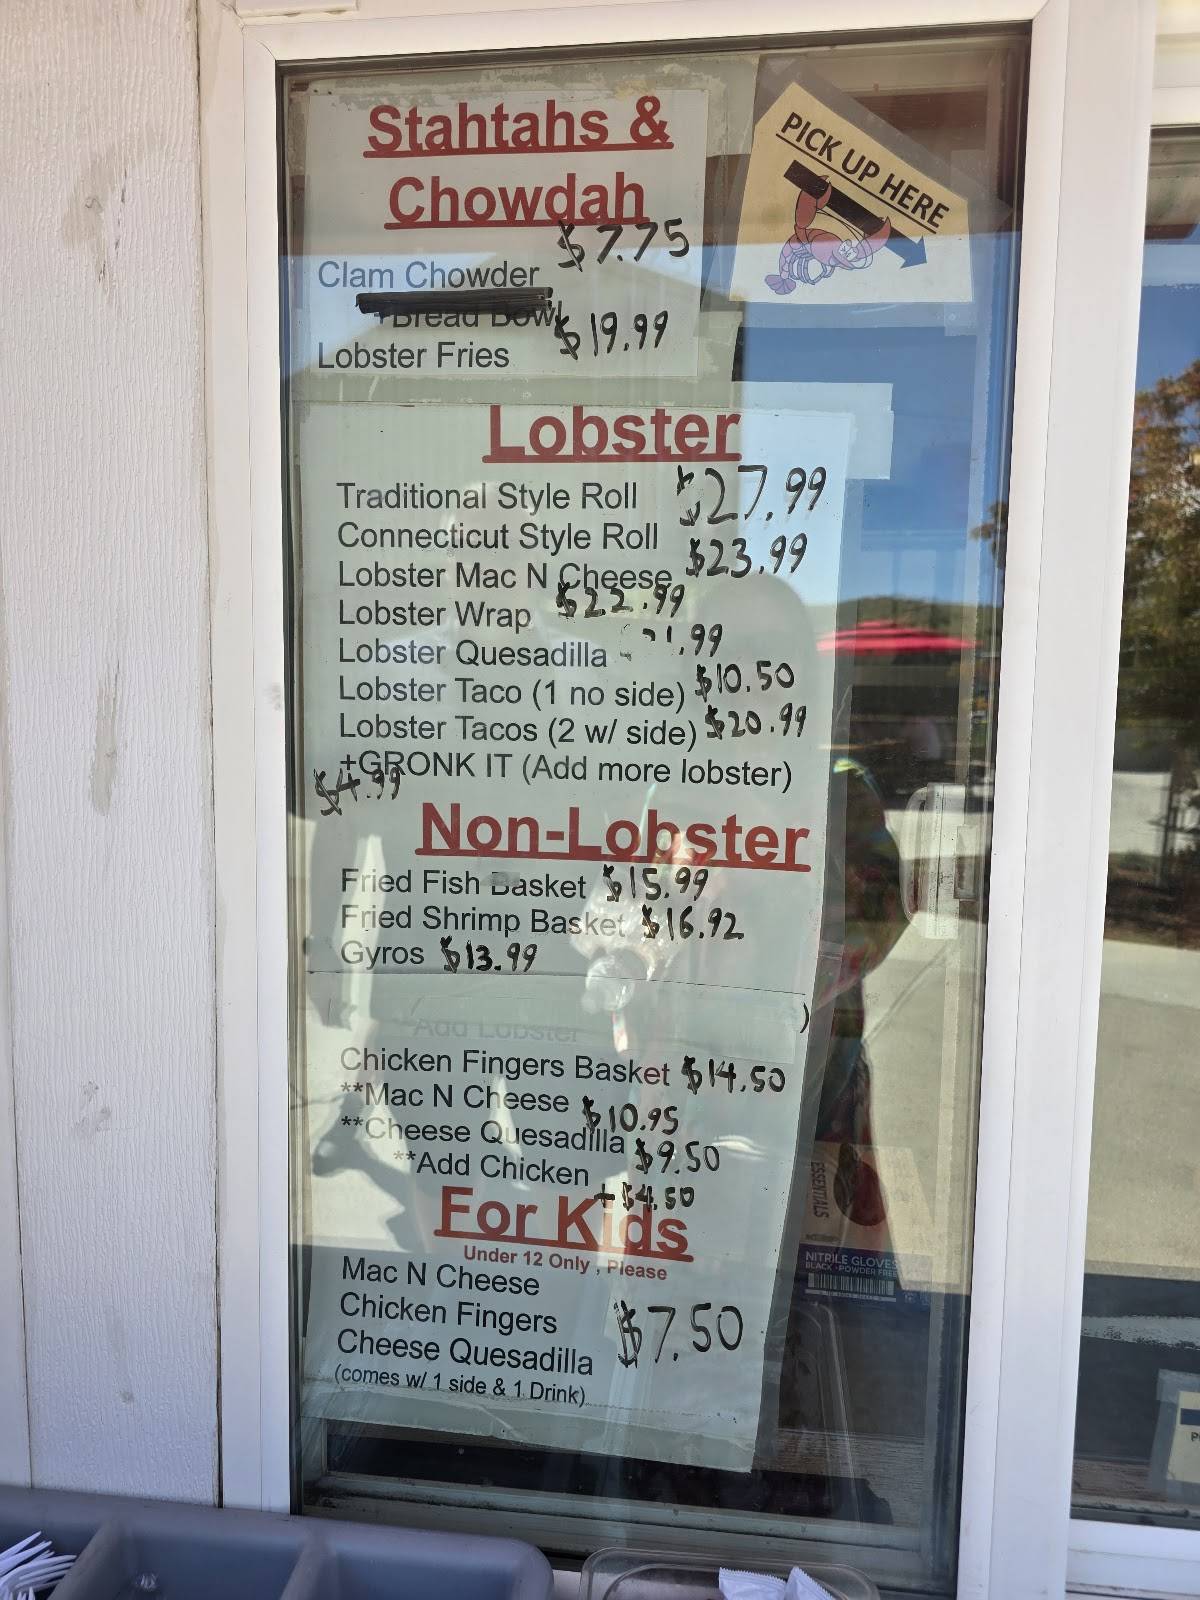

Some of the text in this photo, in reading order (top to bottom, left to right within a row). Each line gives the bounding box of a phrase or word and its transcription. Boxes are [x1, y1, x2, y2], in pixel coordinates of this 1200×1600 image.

[368, 95, 670, 152] Stahtahs &
[780, 111, 949, 229] PICK UP HERE
[389, 172, 646, 223] Chowdah
[557, 218, 690, 272] $7.75
[318, 261, 540, 289] Clam Chowder
[553, 310, 669, 361] $19.99
[318, 341, 510, 370] Lobster Fries
[489, 404, 741, 456] Lobster
[336, 482, 638, 516] Traditional Style Roll
[336, 521, 659, 556] Connecticut Style Roll
[686, 533, 808, 578] $23.99
[338, 561, 673, 591] Lobster Mac N Cheese
[338, 600, 532, 634] Lobster Wrap
[556, 584, 686, 620] $22.99
[338, 638, 608, 669] Lobster Quesadilla
[338, 676, 686, 712] Lobster Taco (1 no side)
[695, 660, 795, 703] $10.50
[339, 714, 697, 752] Lobster Tacos (2 w/ side)
[704, 702, 807, 741] $20.99
[340, 750, 792, 793] +GRONK IT (Add more lobster)
[421, 802, 811, 865] Non-Lobster
[341, 867, 412, 894] Fried
[422, 869, 480, 896] Fish
[603, 864, 709, 902] $15.99
[341, 905, 626, 937] Fried Shrimp Basket
[341, 940, 425, 970] Gyros
[439, 935, 538, 973] $13.99
[340, 1047, 670, 1086] Chicken Fingers Basket
[680, 1056, 786, 1095] $14.50
[432, 1084, 453, 1109] N
[463, 1084, 569, 1113] Cheese
[582, 1097, 679, 1135] $10.95
[480, 1121, 625, 1155] Quesadilla
[635, 1137, 721, 1174] $9.50
[479, 1154, 589, 1187] Chicken
[811, 1161, 829, 1219] ESSENTIALS
[441, 1185, 688, 1257] For Kids
[342, 1255, 540, 1297] Mac N Cheese
[464, 1245, 517, 1264] Under
[523, 1251, 543, 1267] 12
[549, 1253, 590, 1275] Only
[607, 1260, 667, 1281] Please
[805, 1251, 848, 1265] NITRILE
[805, 1261, 833, 1272] BLACK
[878, 1269, 898, 1278] FREE
[339, 1291, 558, 1337] Chicken Fingers
[337, 1328, 593, 1377] Cheese Quesadilla
[614, 1300, 744, 1368] $7.50
[334, 1362, 587, 1408] (comes w/ 1 side & 1 Drink)
